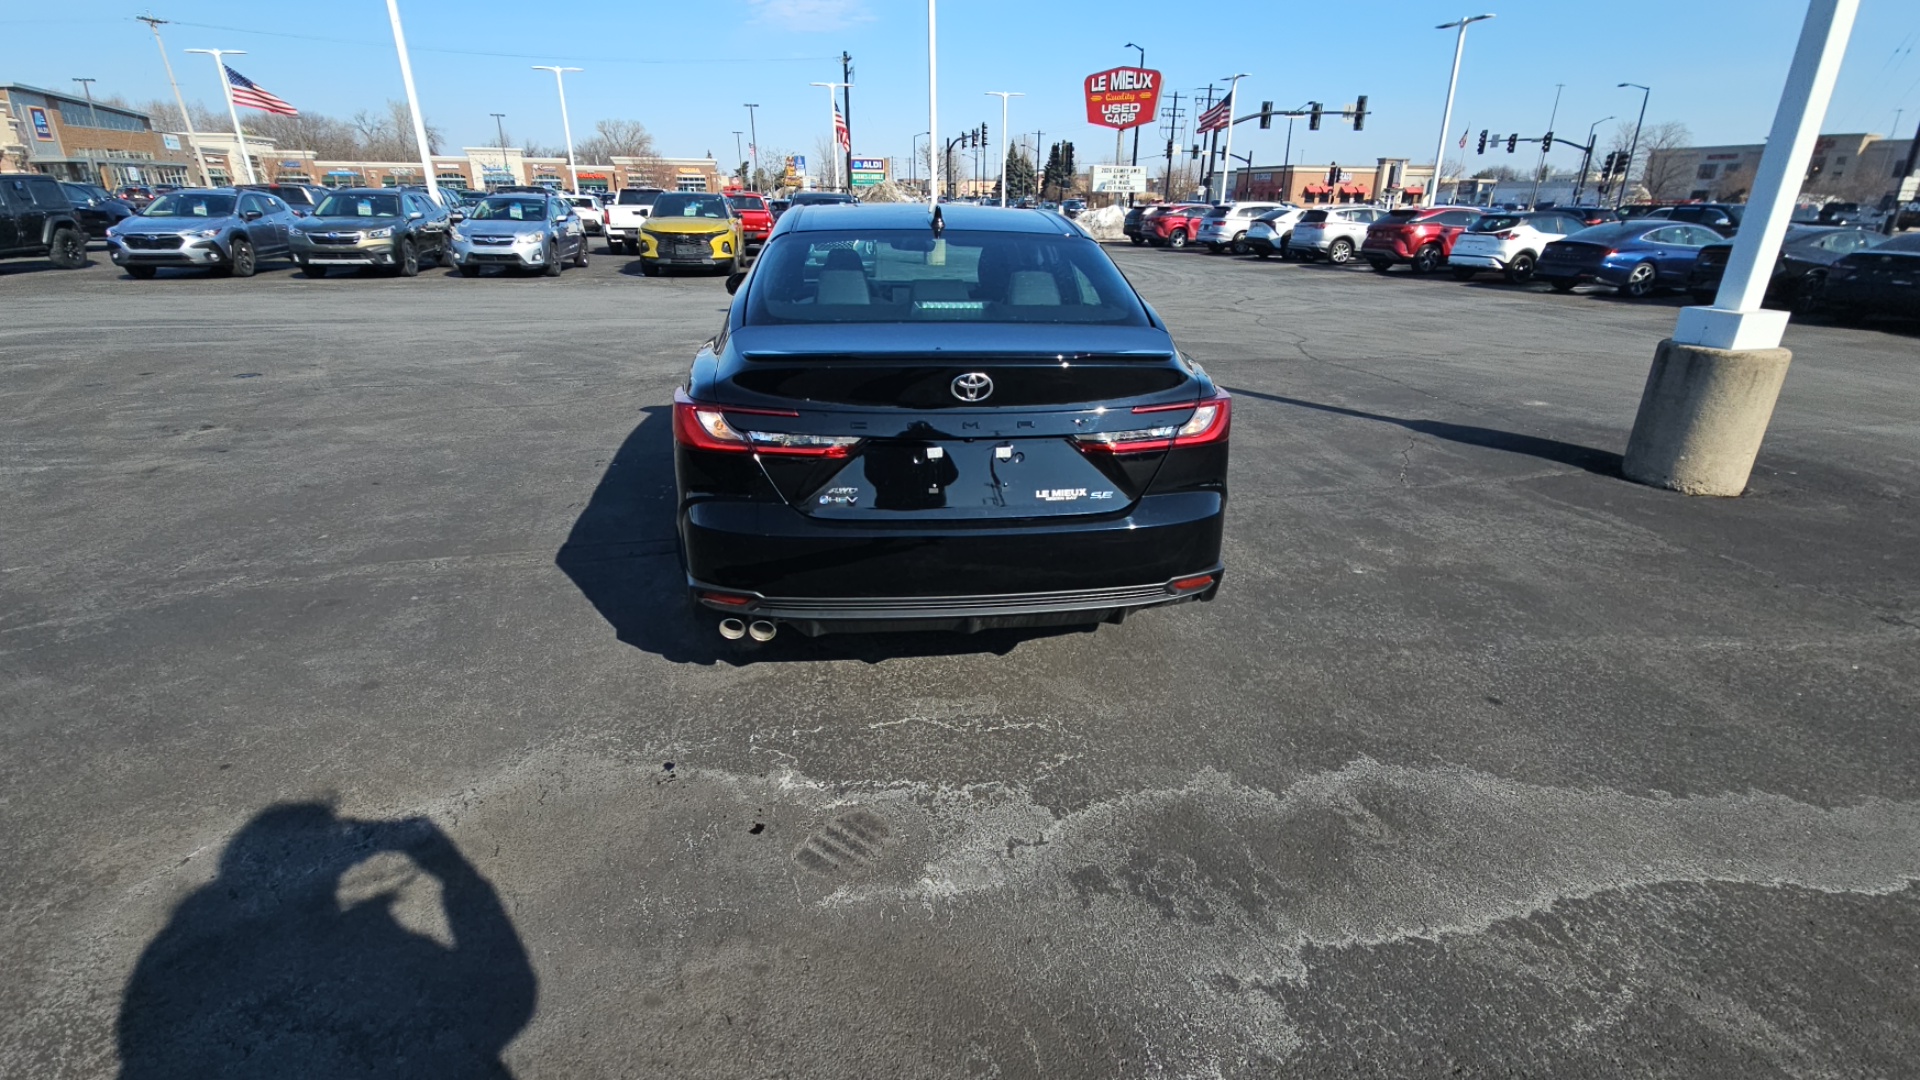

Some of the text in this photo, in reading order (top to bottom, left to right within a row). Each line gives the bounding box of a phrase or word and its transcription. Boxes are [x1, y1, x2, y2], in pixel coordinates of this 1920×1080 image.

[1091, 70, 1153, 92] LE MIEUX
[1105, 92, 1135, 101] Quality
[1101, 103, 1141, 114] USED
[1105, 113, 1136, 125] CARS
[862, 160, 882, 169] ALDI
[1035, 488, 1087, 499] LE MIEUX
[1090, 491, 1114, 500] SE
